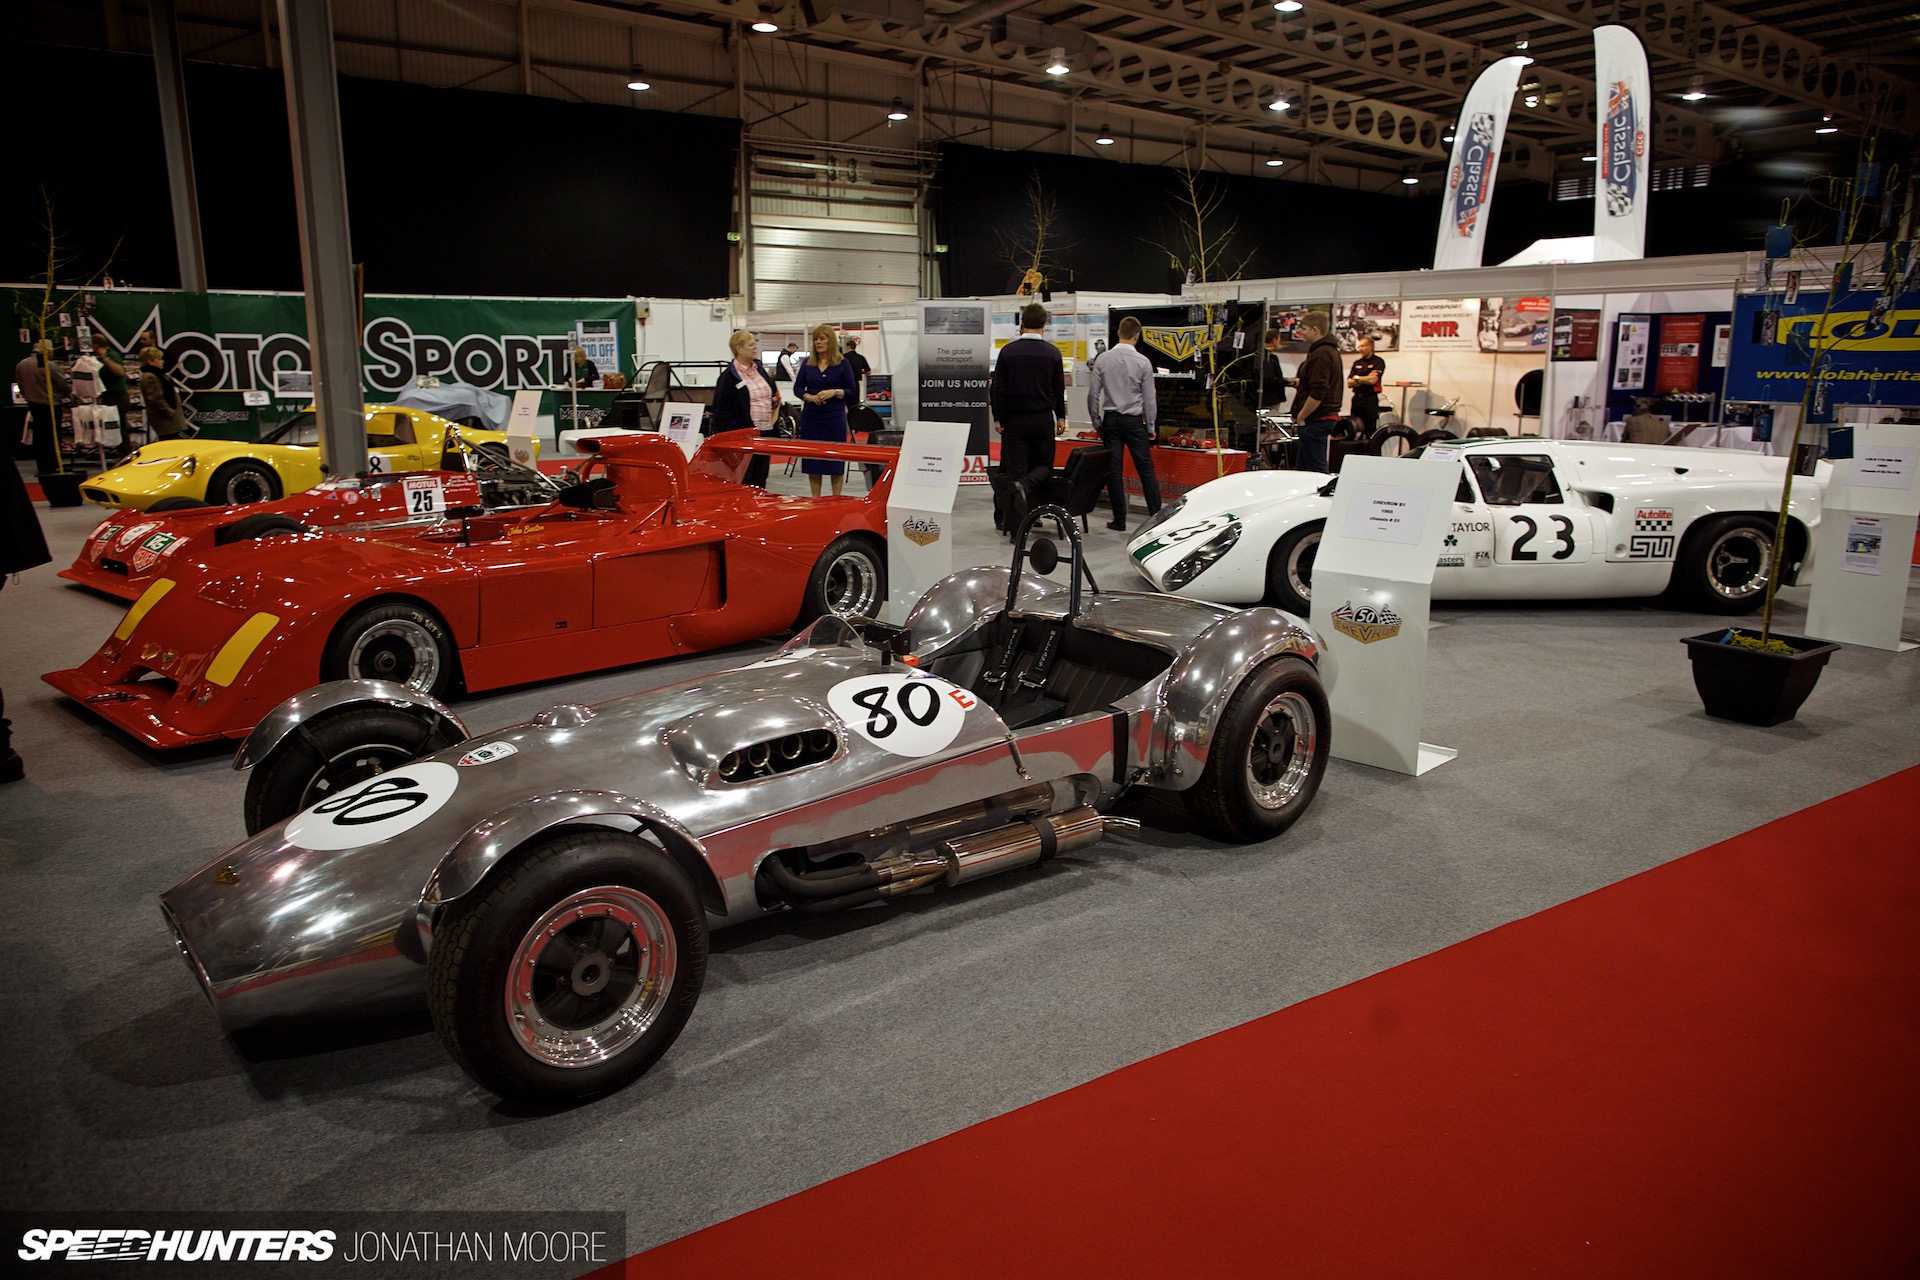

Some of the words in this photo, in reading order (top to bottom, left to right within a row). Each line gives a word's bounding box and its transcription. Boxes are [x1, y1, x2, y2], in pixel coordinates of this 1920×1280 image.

[1421, 321, 1459, 337] BMTR
[1533, 332, 1547, 340] AV
[86, 303, 367, 391] MOTO
[363, 317, 575, 393] SPORT
[599, 344, 614, 357] OFF
[951, 348, 972, 357] global
[936, 356, 973, 365] motorsport
[1756, 369, 1920, 381] www.lolaherita
[921, 379, 945, 388] JOIN
[947, 379, 961, 388] US
[963, 379, 987, 388] NOW
[921, 400, 987, 408] www.the-mia.com
[408, 480, 437, 489] MOTUL
[412, 489, 434, 513] 25
[1637, 510, 1672, 519] Autolite
[1451, 522, 1491, 532] TAYLOR
[1510, 514, 1576, 561] 23
[1356, 609, 1375, 623] 50
[948, 689, 975, 709] E
[852, 682, 941, 739] 80
[312, 777, 428, 826] 80
